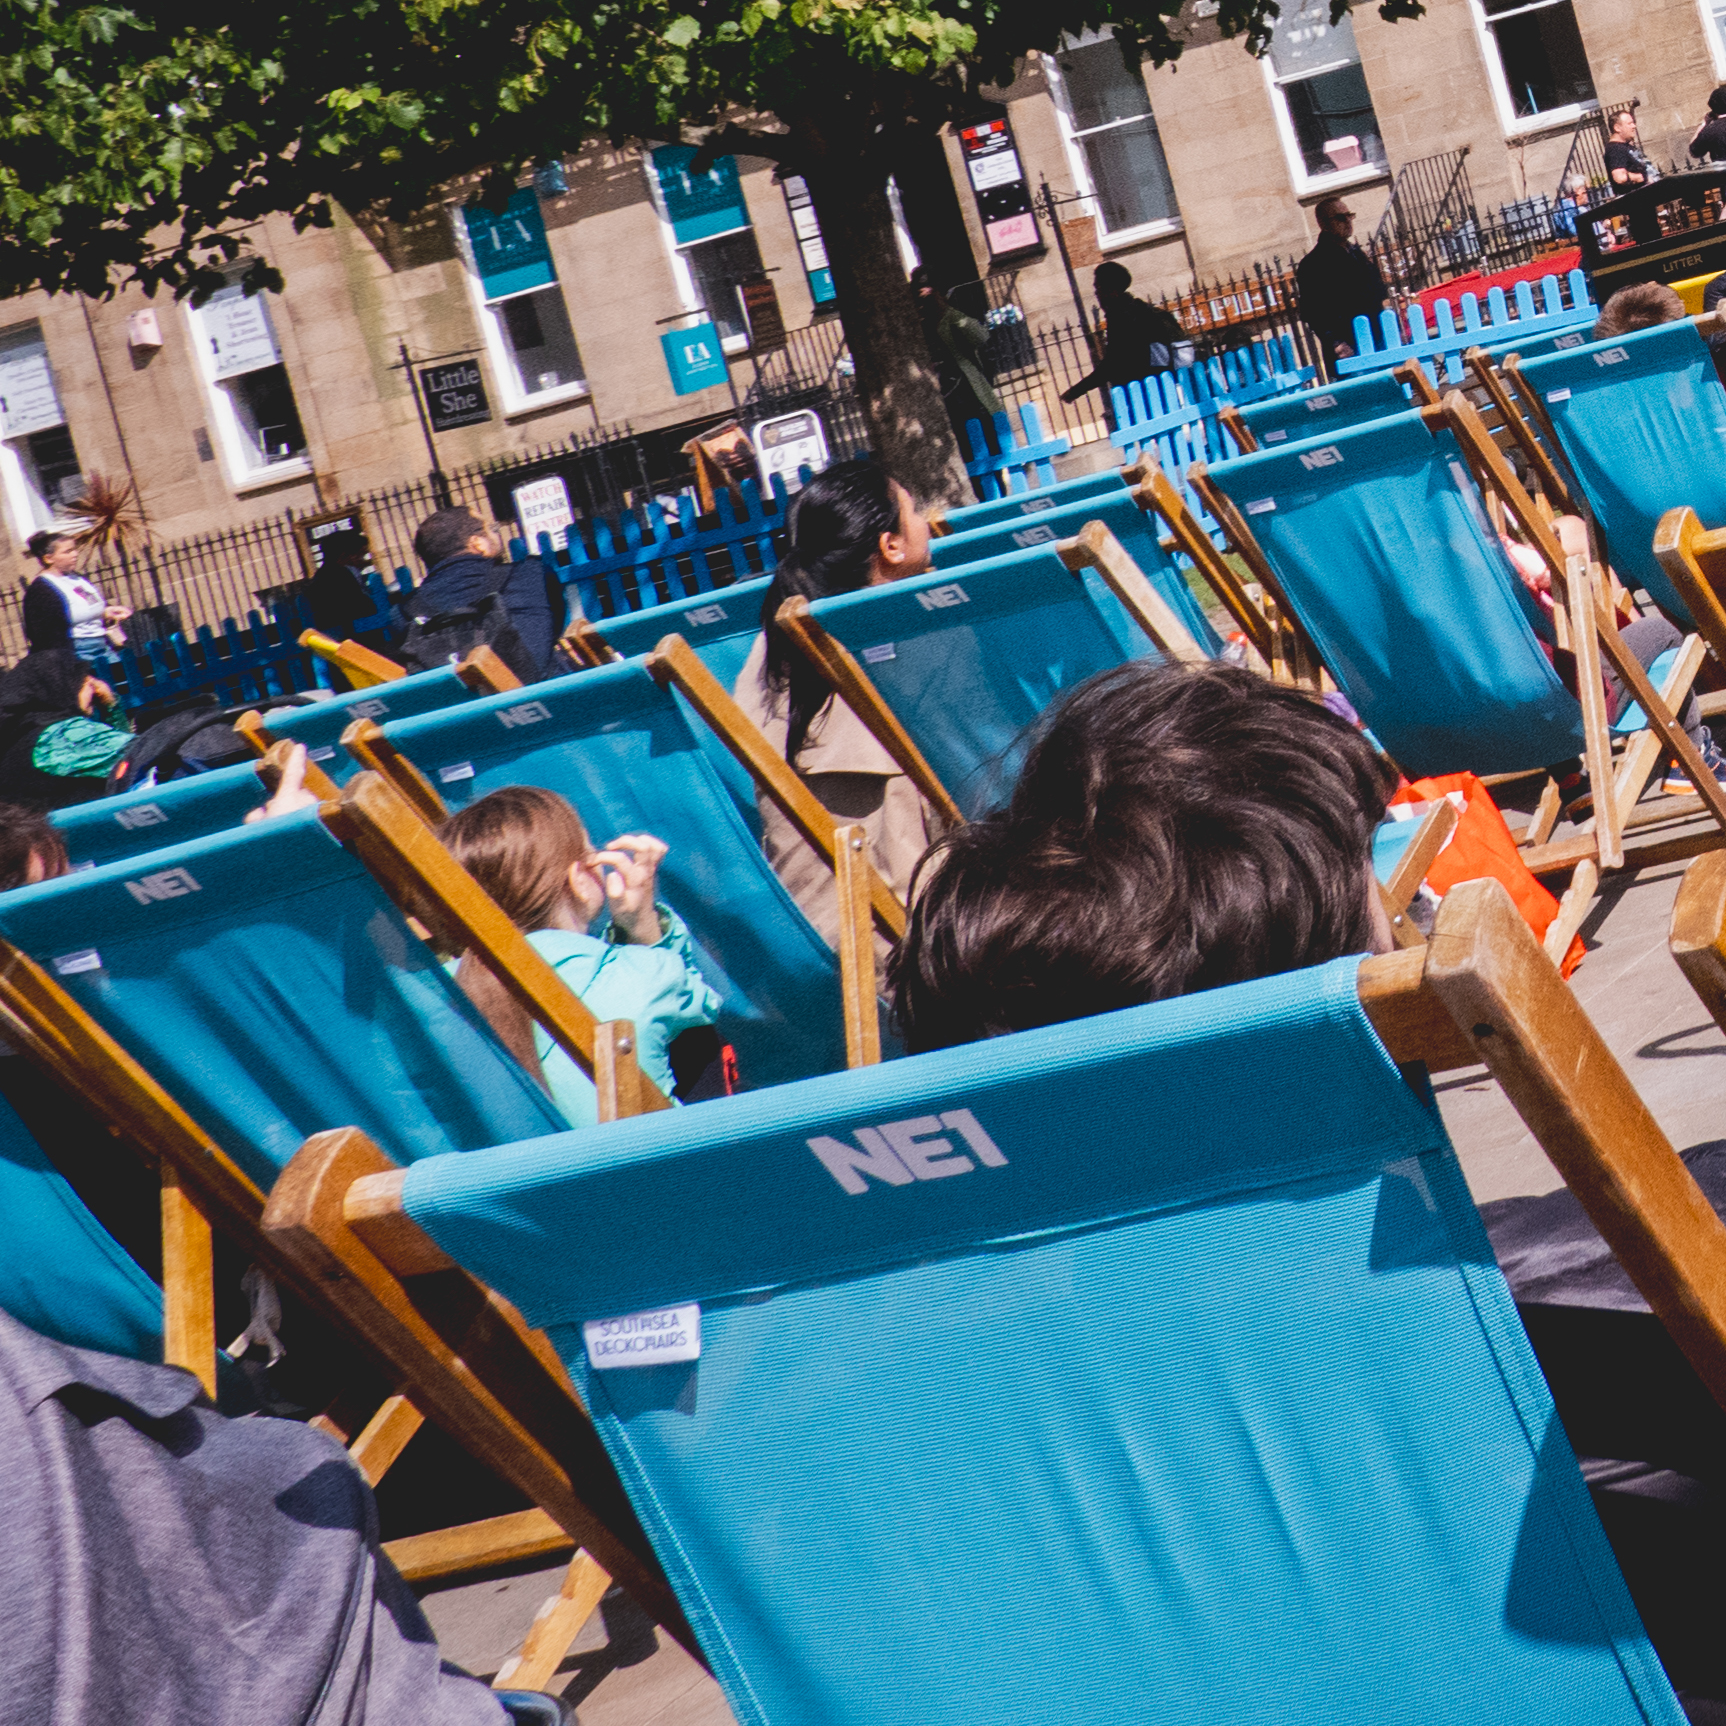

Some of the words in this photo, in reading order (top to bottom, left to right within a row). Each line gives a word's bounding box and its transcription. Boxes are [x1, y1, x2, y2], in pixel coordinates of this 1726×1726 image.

[1663, 254, 1703, 273] LITTER
[1553, 331, 1586, 350] NE1
[1593, 347, 1629, 366] NE1
[426, 366, 480, 393] Little
[440, 391, 478, 413] She
[1306, 394, 1337, 411] NE1
[1299, 446, 1343, 470] NE1
[521, 483, 563, 503] WATCH
[524, 498, 568, 518] REPAIR
[1020, 498, 1054, 515] NE1
[1011, 524, 1054, 547] NE1
[916, 584, 969, 610] NE1
[685, 604, 727, 626] NE1
[345, 699, 391, 719] NE1
[496, 701, 551, 728] NE1
[114, 803, 167, 829] NE1
[125, 868, 201, 904] NE1
[807, 1109, 1007, 1194] NE1
[600, 1310, 680, 1337] SOUTHSEA
[594, 1330, 687, 1356] DECKCHAIRS
